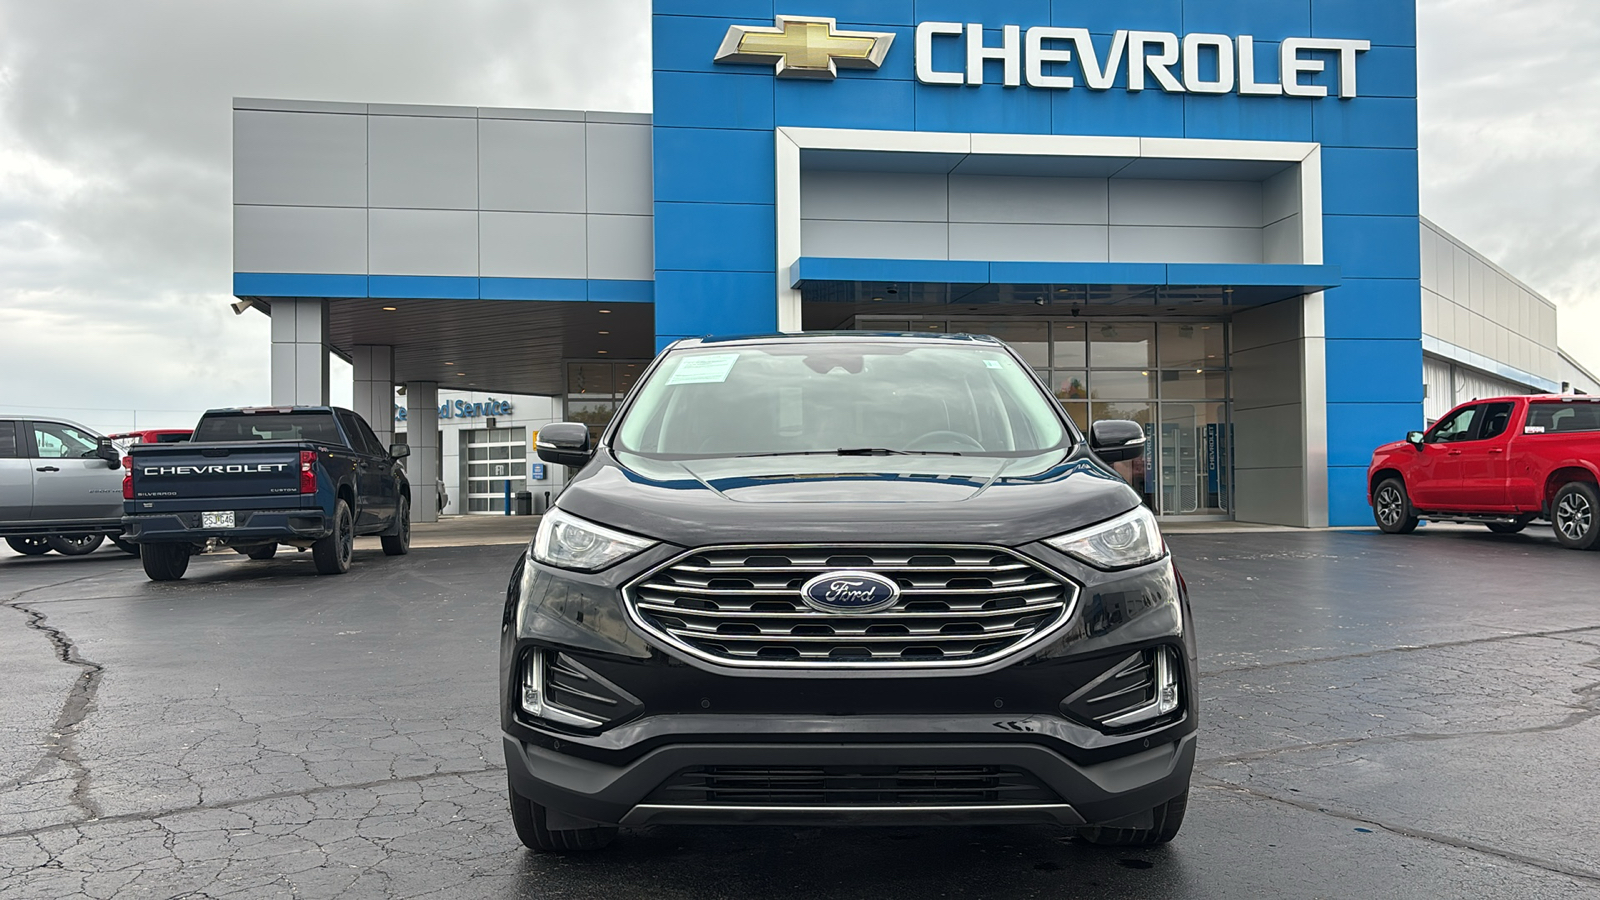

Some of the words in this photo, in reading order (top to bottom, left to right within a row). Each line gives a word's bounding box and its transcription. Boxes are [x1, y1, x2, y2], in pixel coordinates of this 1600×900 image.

[914, 20, 1371, 99] CHEVROLET
[454, 397, 512, 419] Service
[144, 463, 288, 476] CHEVROLET
[825, 580, 876, 602] Ford
